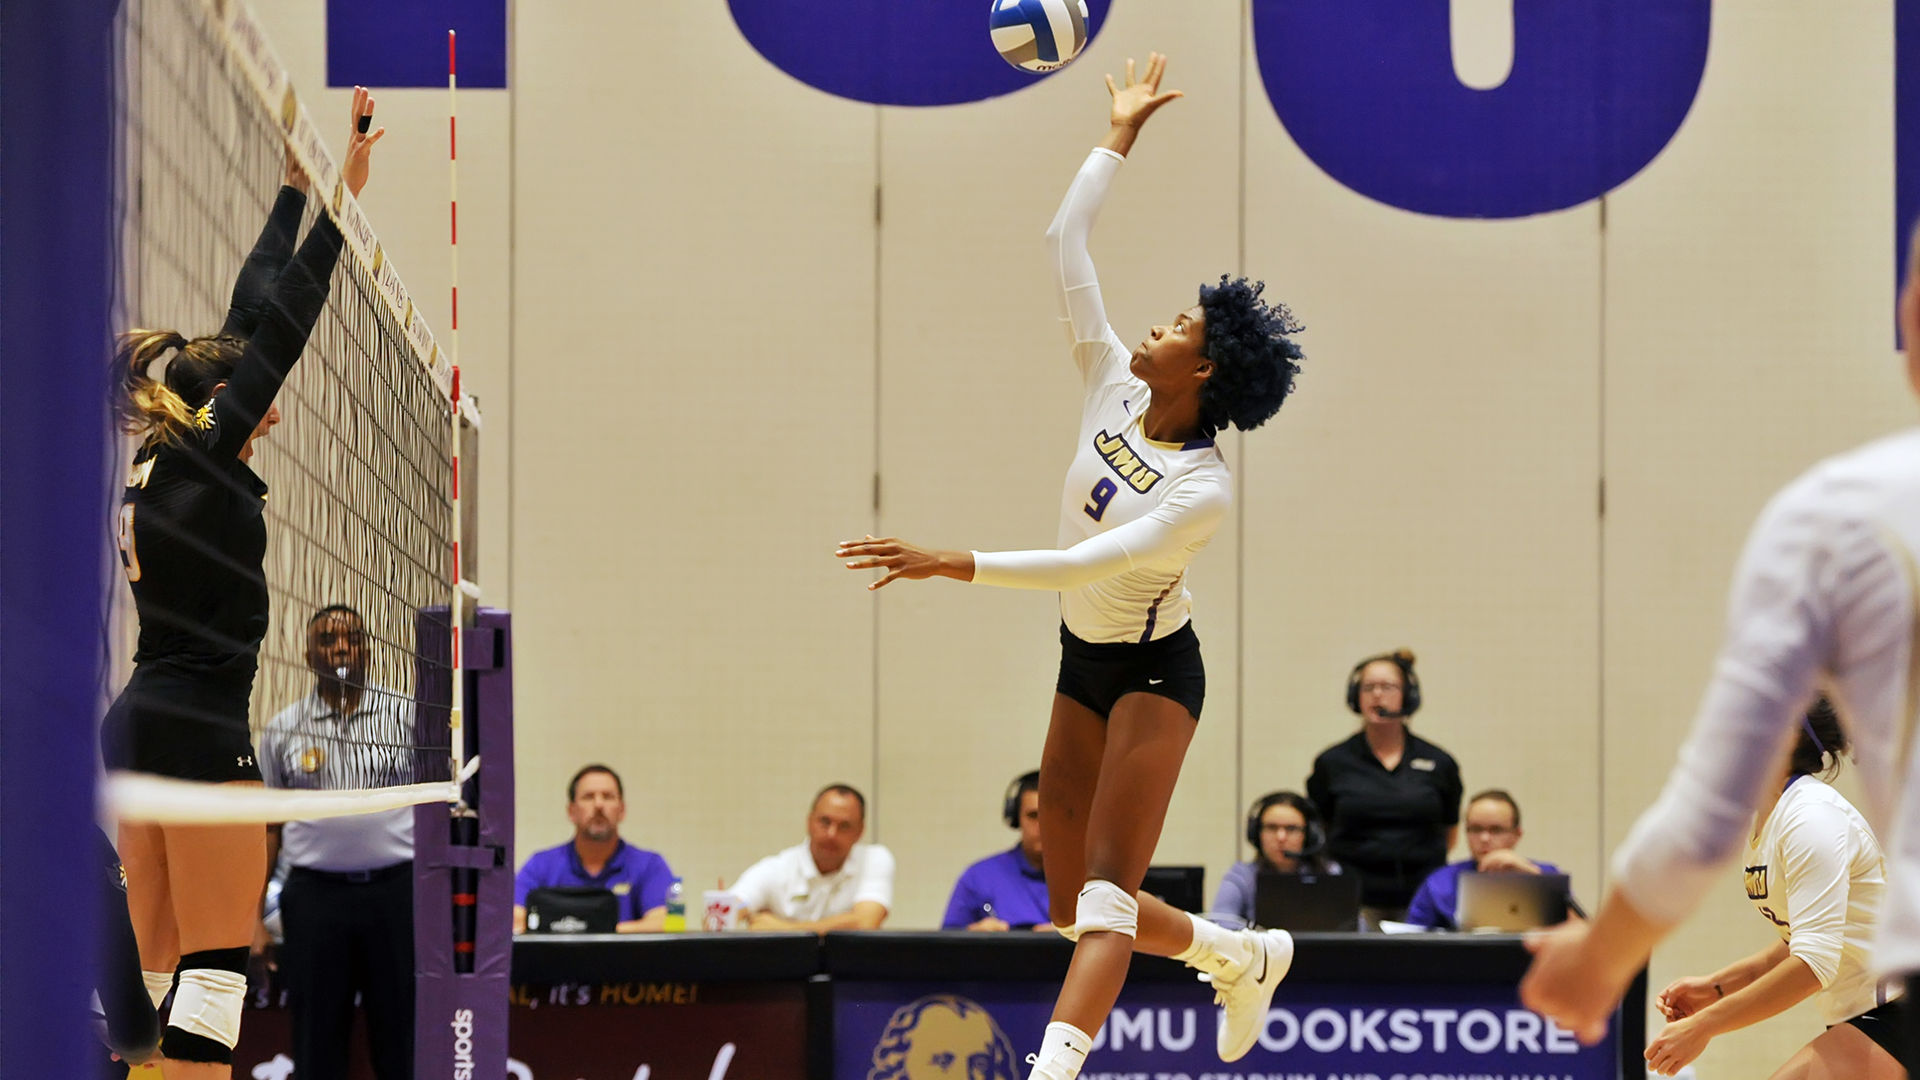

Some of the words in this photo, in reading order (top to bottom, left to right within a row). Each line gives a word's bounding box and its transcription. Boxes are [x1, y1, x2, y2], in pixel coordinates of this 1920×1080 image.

[1094, 429, 1164, 494] JMU
[1083, 476, 1118, 522] 9
[450, 1008, 474, 1080] sports
[1217, 1008, 1579, 1053] OOKSTORE
